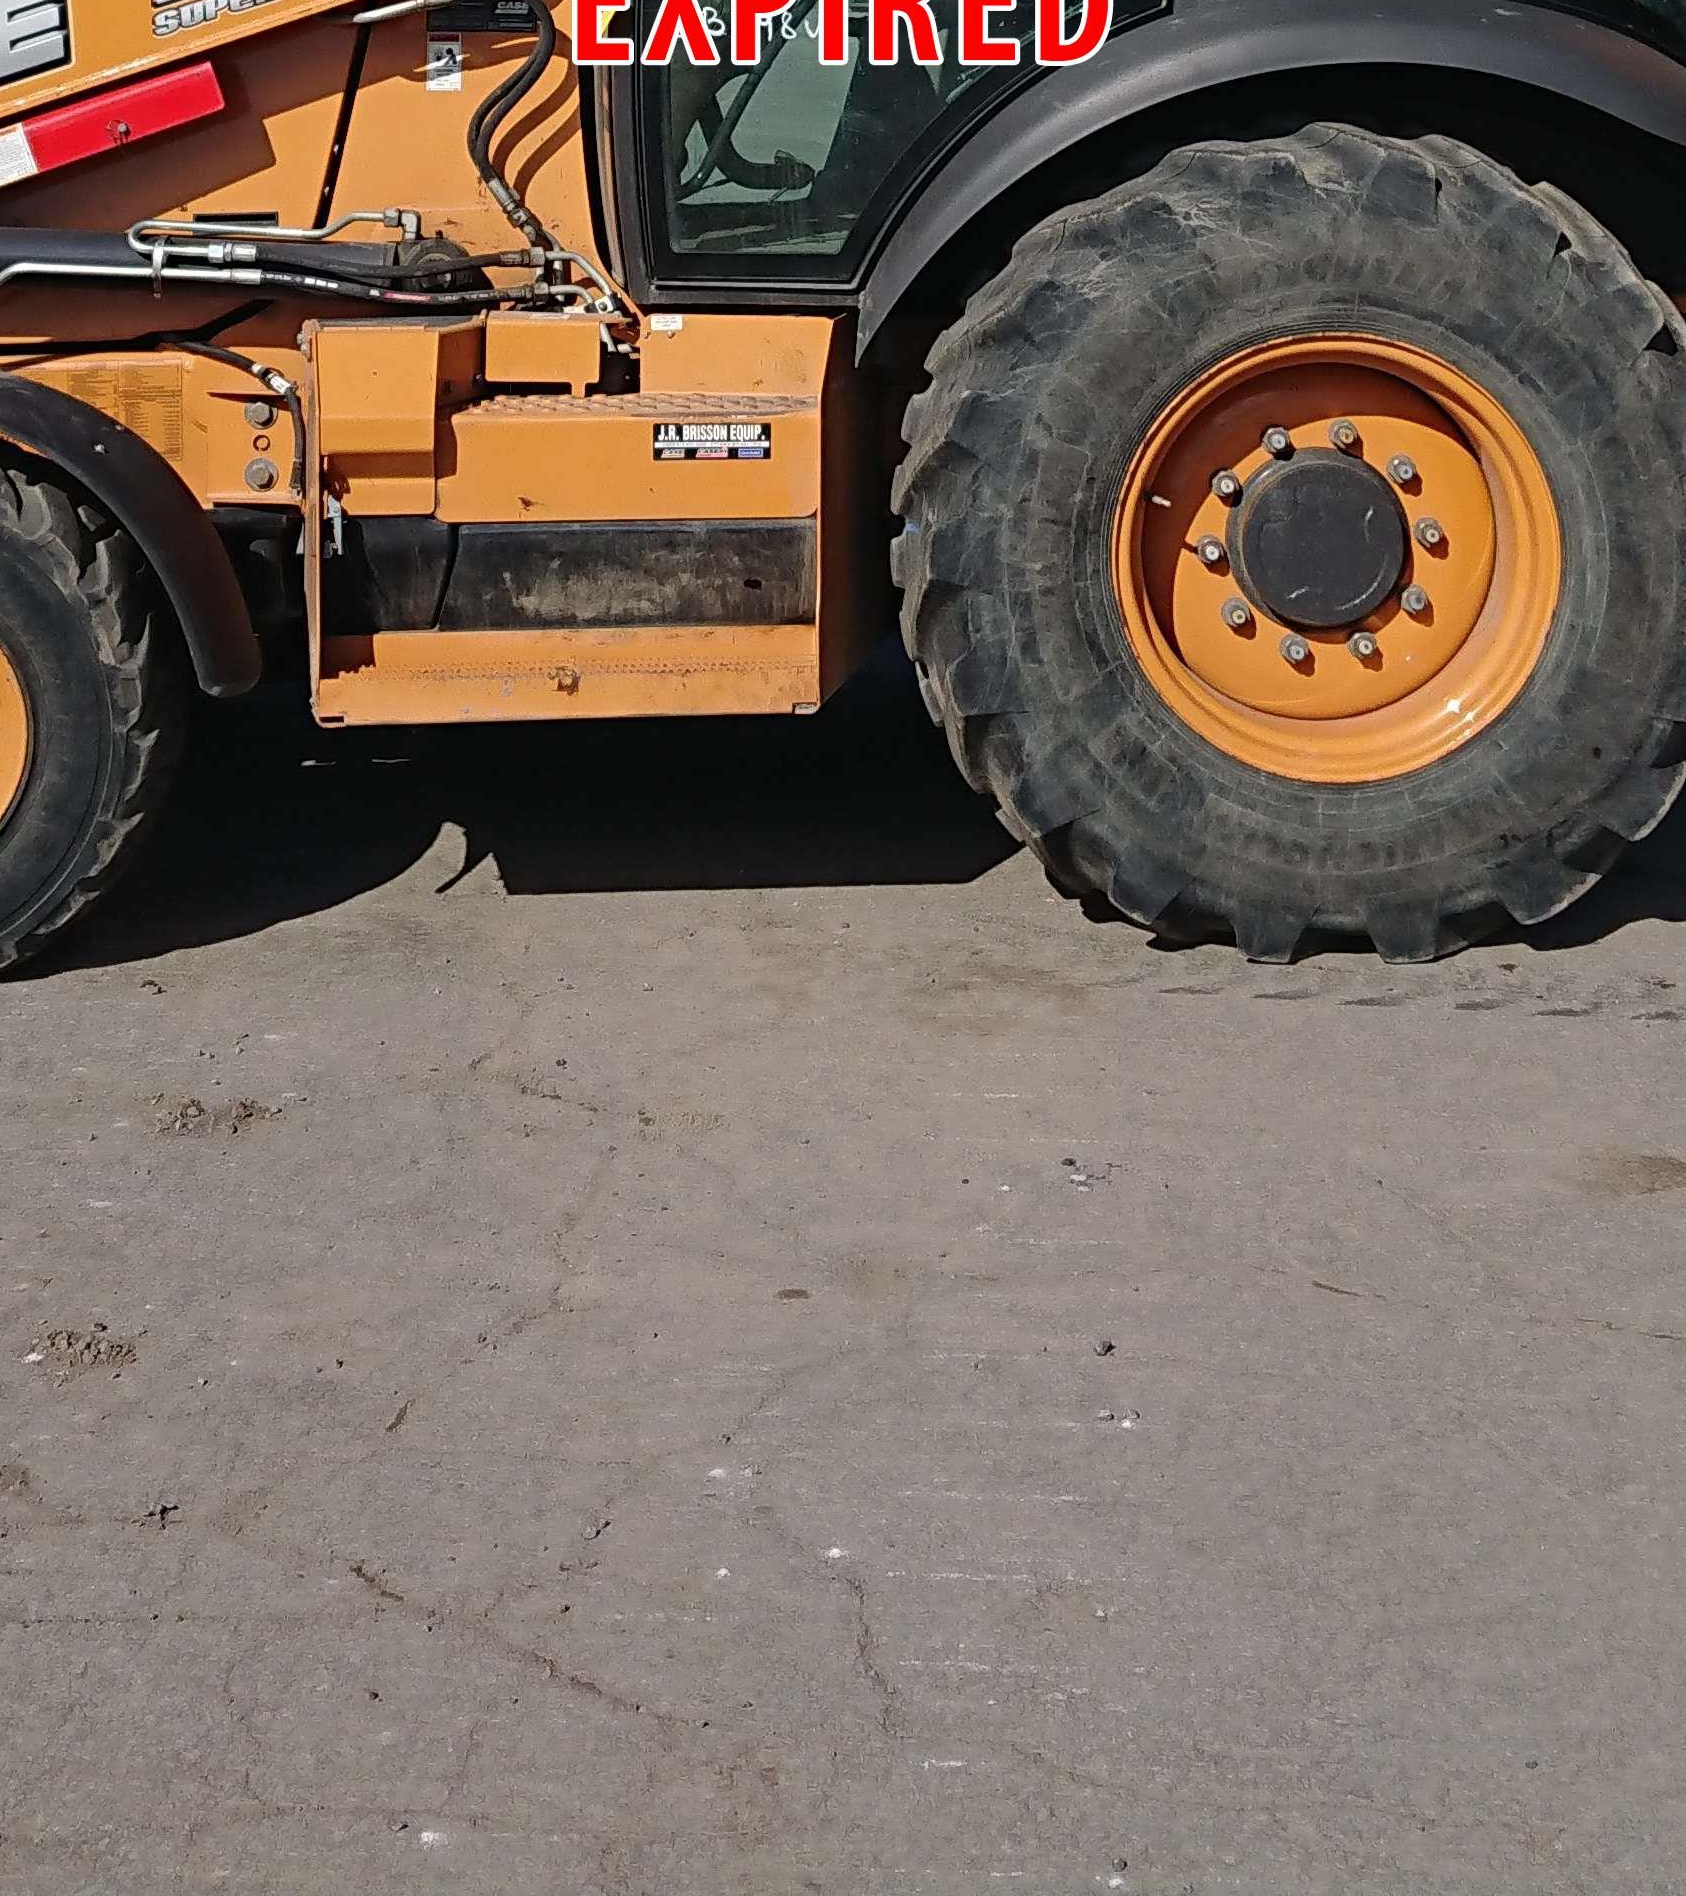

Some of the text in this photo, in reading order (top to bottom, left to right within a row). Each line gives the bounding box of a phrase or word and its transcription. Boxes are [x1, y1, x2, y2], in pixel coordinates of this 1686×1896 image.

[657, 424, 766, 442] J.R. BRISSON EQUIP.
